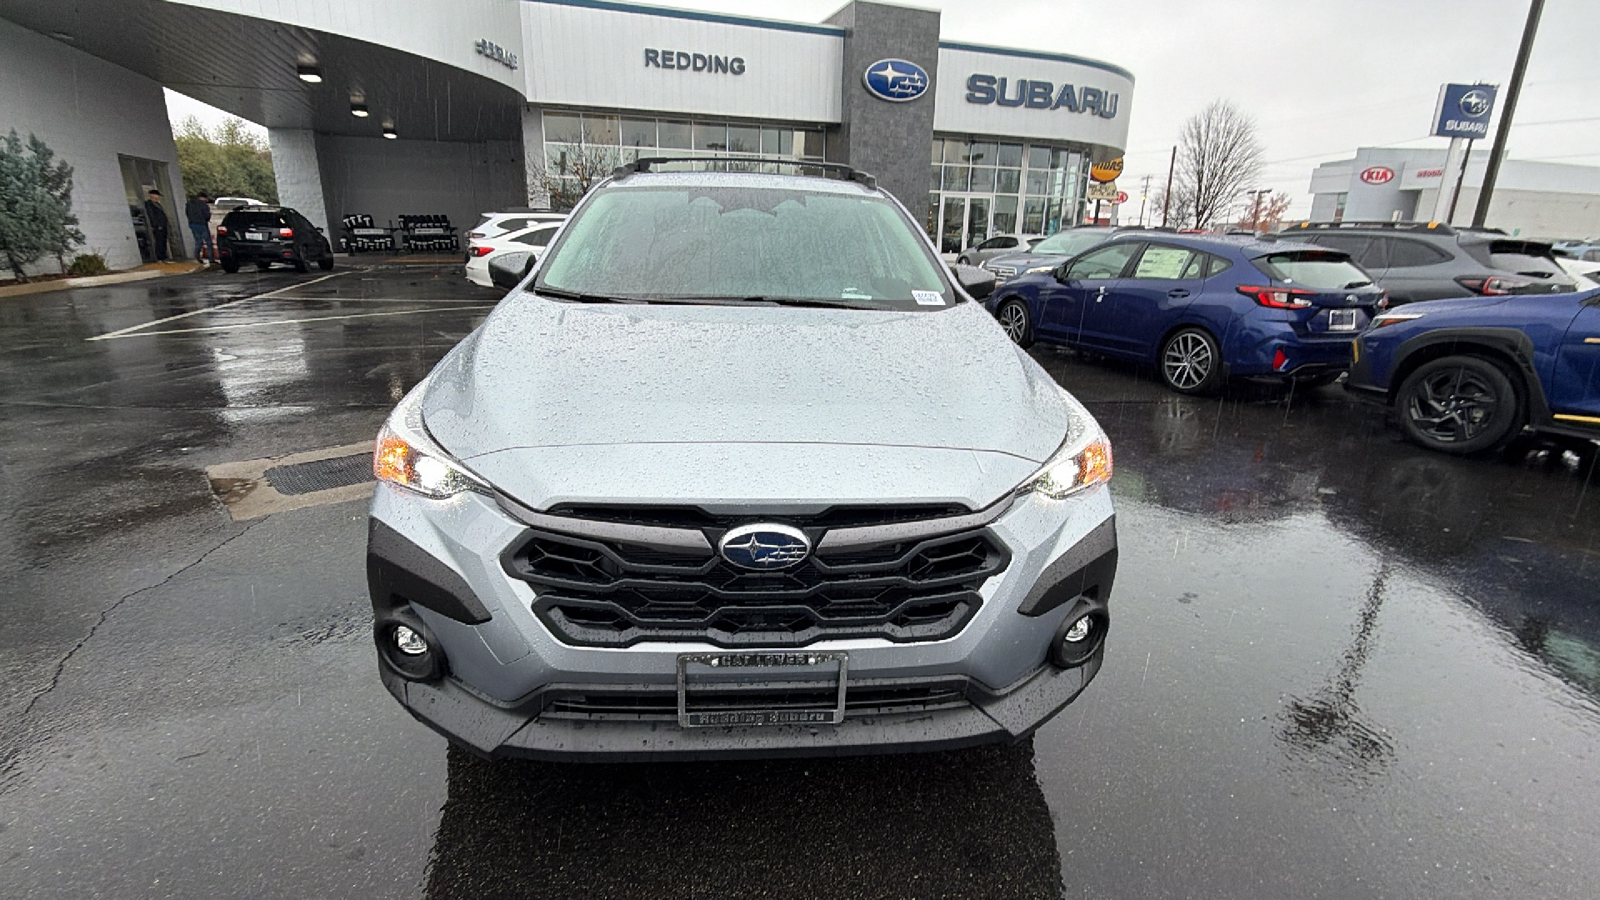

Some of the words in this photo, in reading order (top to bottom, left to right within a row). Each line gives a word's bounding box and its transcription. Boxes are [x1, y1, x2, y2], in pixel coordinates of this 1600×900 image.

[644, 48, 746, 76] REDDING
[966, 74, 1119, 119] SUBARU
[1445, 119, 1488, 134] SUBARU
[1366, 170, 1389, 182] KIA
